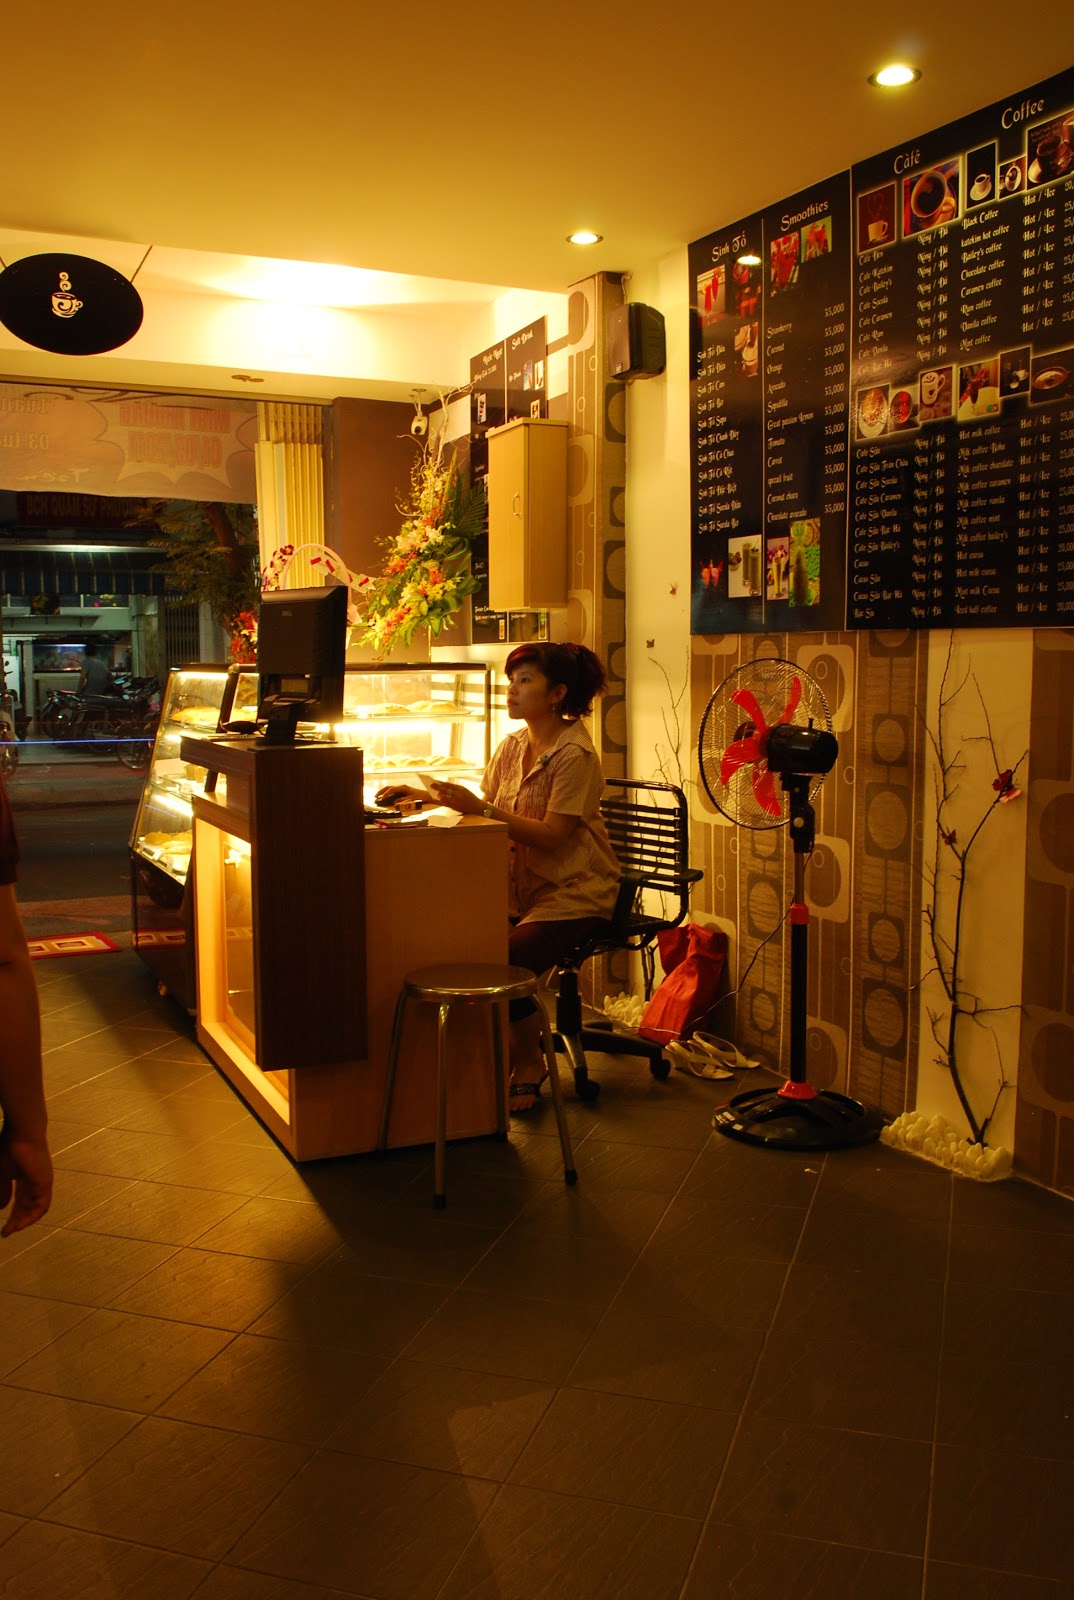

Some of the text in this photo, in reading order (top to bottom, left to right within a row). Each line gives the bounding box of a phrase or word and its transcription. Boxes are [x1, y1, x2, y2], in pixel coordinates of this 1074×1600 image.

[1001, 99, 1045, 130] Coffee
[1024, 187, 1056, 206] Hot Ice
[780, 201, 829, 232] Smoothies
[961, 209, 999, 230] Black Coffee
[1023, 208, 1055, 226] Hot Ice
[982, 230, 992, 240] hot
[992, 224, 1010, 237] coffee
[1024, 223, 1055, 242] Hot Ice
[711, 244, 730, 262] Sinh
[985, 242, 1002, 254] coffee
[1023, 242, 1055, 260] Hot Ice
[960, 259, 1005, 281] Chocolate coffee
[1023, 261, 1055, 278] Hot Ice
[985, 278, 1003, 290] coffee
[1023, 279, 1054, 296] Hot Ice
[975, 299, 992, 310] coffee
[1022, 298, 1054, 314] Hot Ice
[981, 315, 998, 326] coffee
[1021, 322, 1034, 333] Hot
[975, 334, 991, 346] coffee
